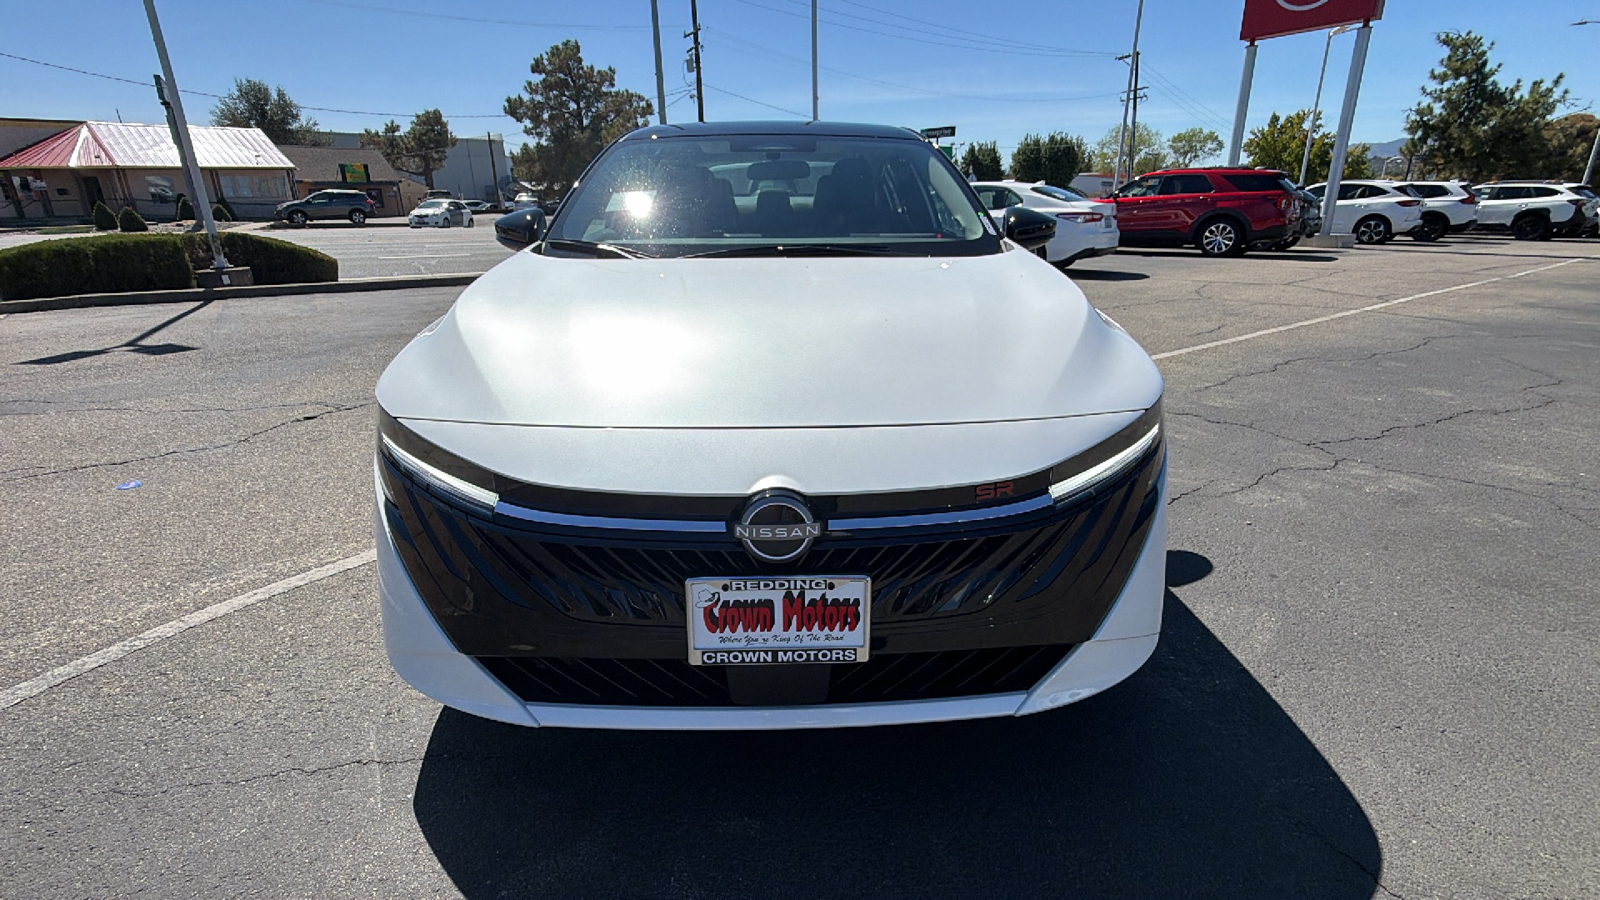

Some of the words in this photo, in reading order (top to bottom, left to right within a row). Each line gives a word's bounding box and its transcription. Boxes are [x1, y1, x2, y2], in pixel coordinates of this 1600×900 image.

[975, 481, 1014, 500] SR
[736, 525, 819, 538] NISSAN
[731, 580, 826, 591] REDDING
[703, 592, 775, 634] Crown
[782, 590, 861, 633] Motors
[718, 635, 743, 644] Where
[744, 634, 769, 646] You're
[772, 634, 791, 644] King
[793, 634, 804, 643] Of
[806, 633, 822, 642] The
[824, 633, 846, 642] Road
[702, 652, 772, 664] CROWN
[777, 650, 856, 663] MOTORS
